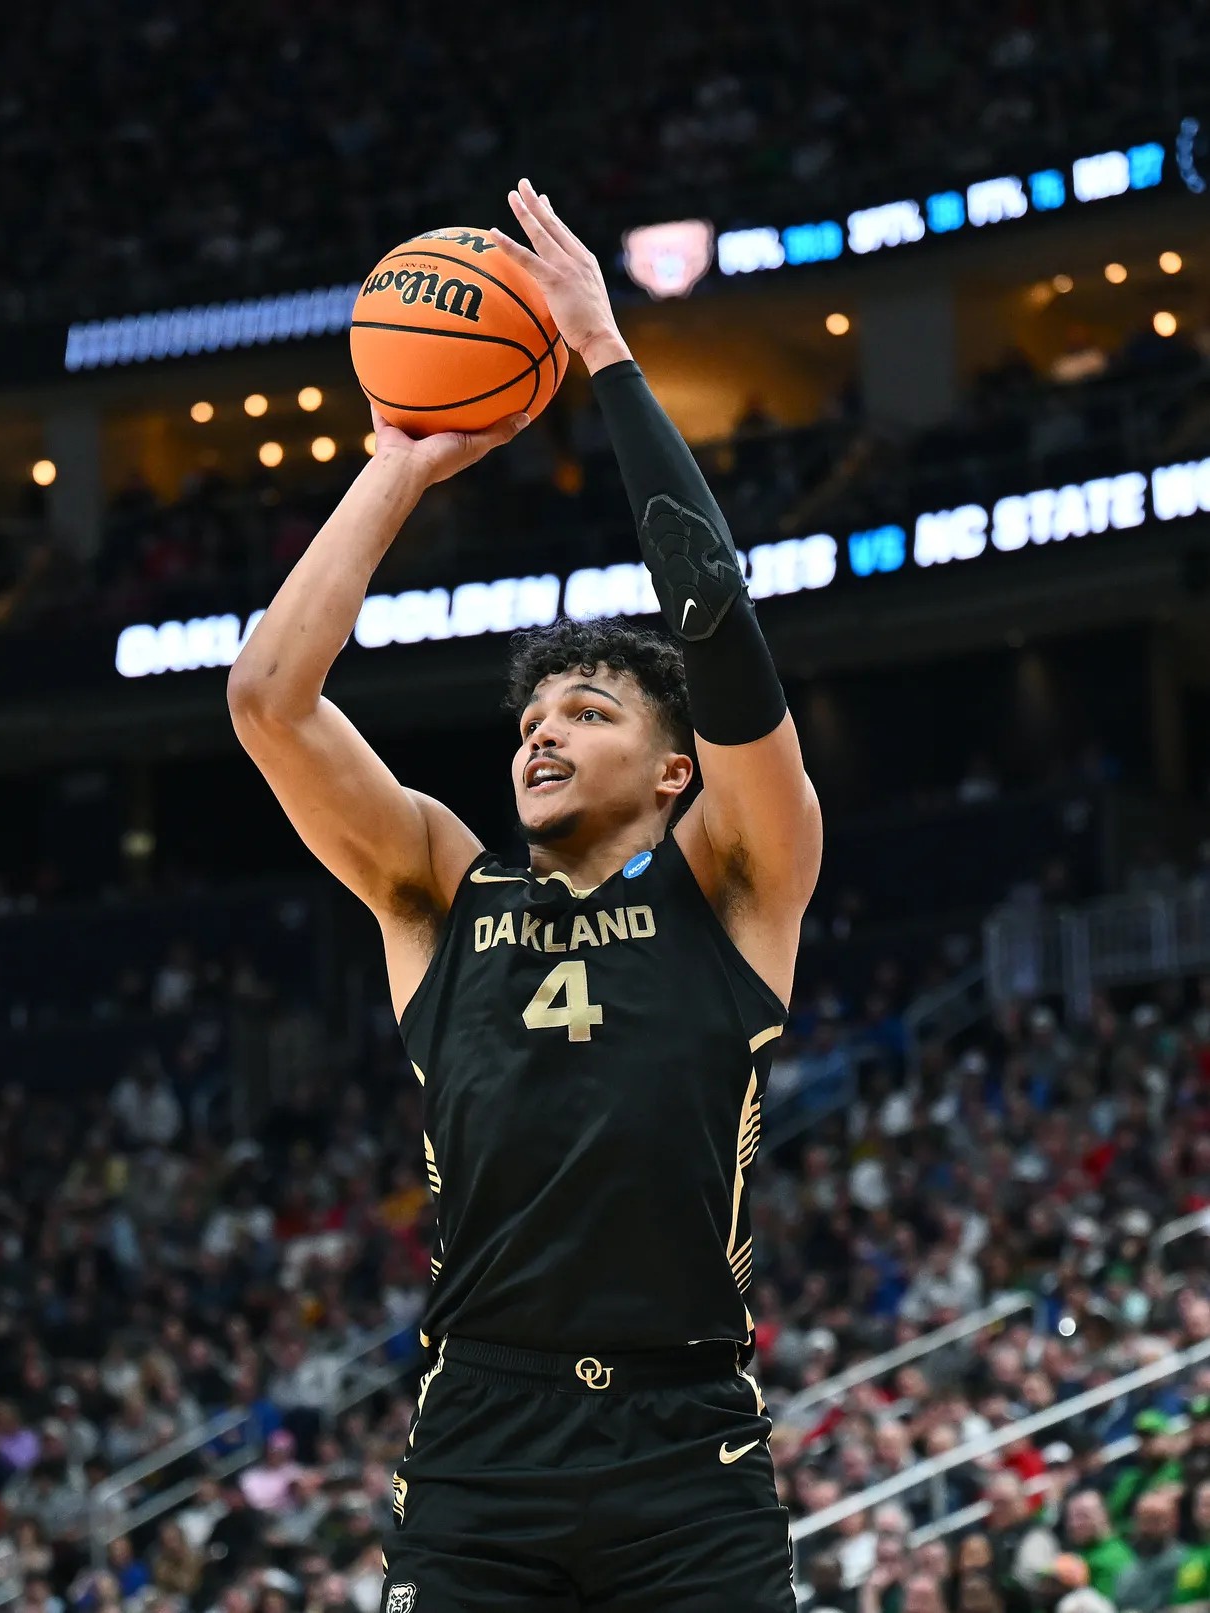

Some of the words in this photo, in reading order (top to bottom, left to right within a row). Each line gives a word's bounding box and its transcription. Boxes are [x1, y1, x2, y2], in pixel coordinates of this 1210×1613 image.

[363, 270, 482, 323] Wilson
[848, 525, 906, 577] VS
[914, 503, 989, 568] NC
[991, 471, 1148, 552] STATE
[627, 855, 651, 876] NCAA
[474, 904, 657, 954] OAKLAND
[521, 959, 604, 1043] 4
[575, 1357, 614, 1390] OU
